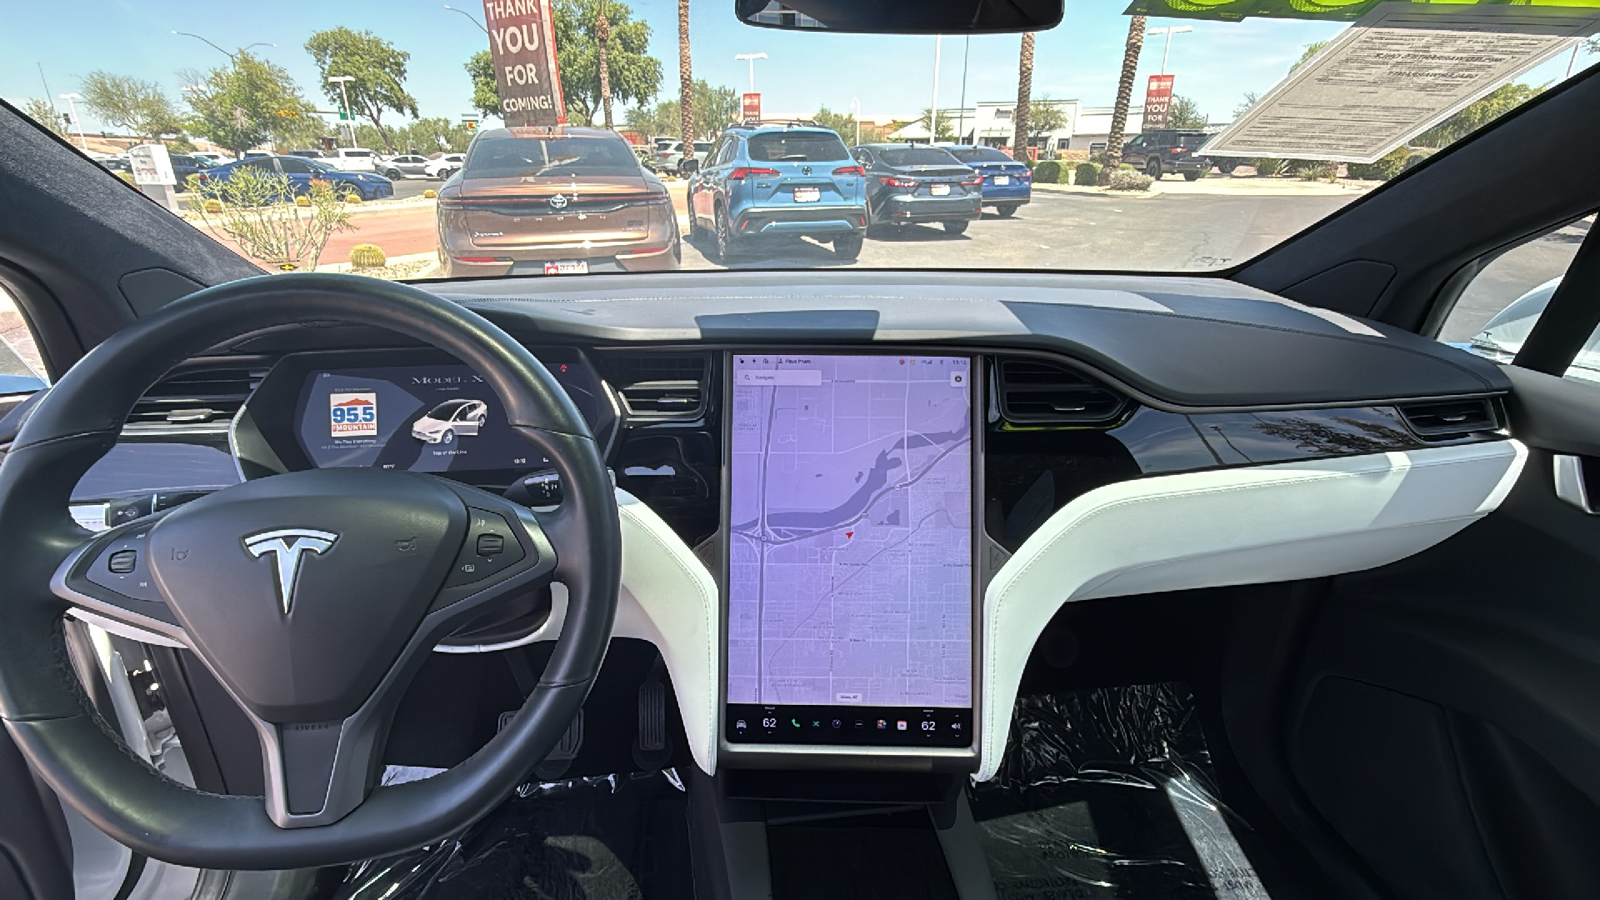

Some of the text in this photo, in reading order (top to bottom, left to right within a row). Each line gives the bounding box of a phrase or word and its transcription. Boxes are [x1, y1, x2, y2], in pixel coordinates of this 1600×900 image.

[486, 0, 538, 20] THANK
[491, 23, 539, 56] YOU
[504, 63, 539, 87] FOR
[503, 94, 552, 112] COMING!
[1146, 103, 1168, 113] YOU
[1147, 114, 1163, 122] FOR
[411, 375, 484, 384] MODEL X
[332, 406, 375, 424] 95.5
[337, 423, 376, 432] MOUNTAIN
[762, 717, 777, 728] 62
[921, 720, 936, 731] 62
